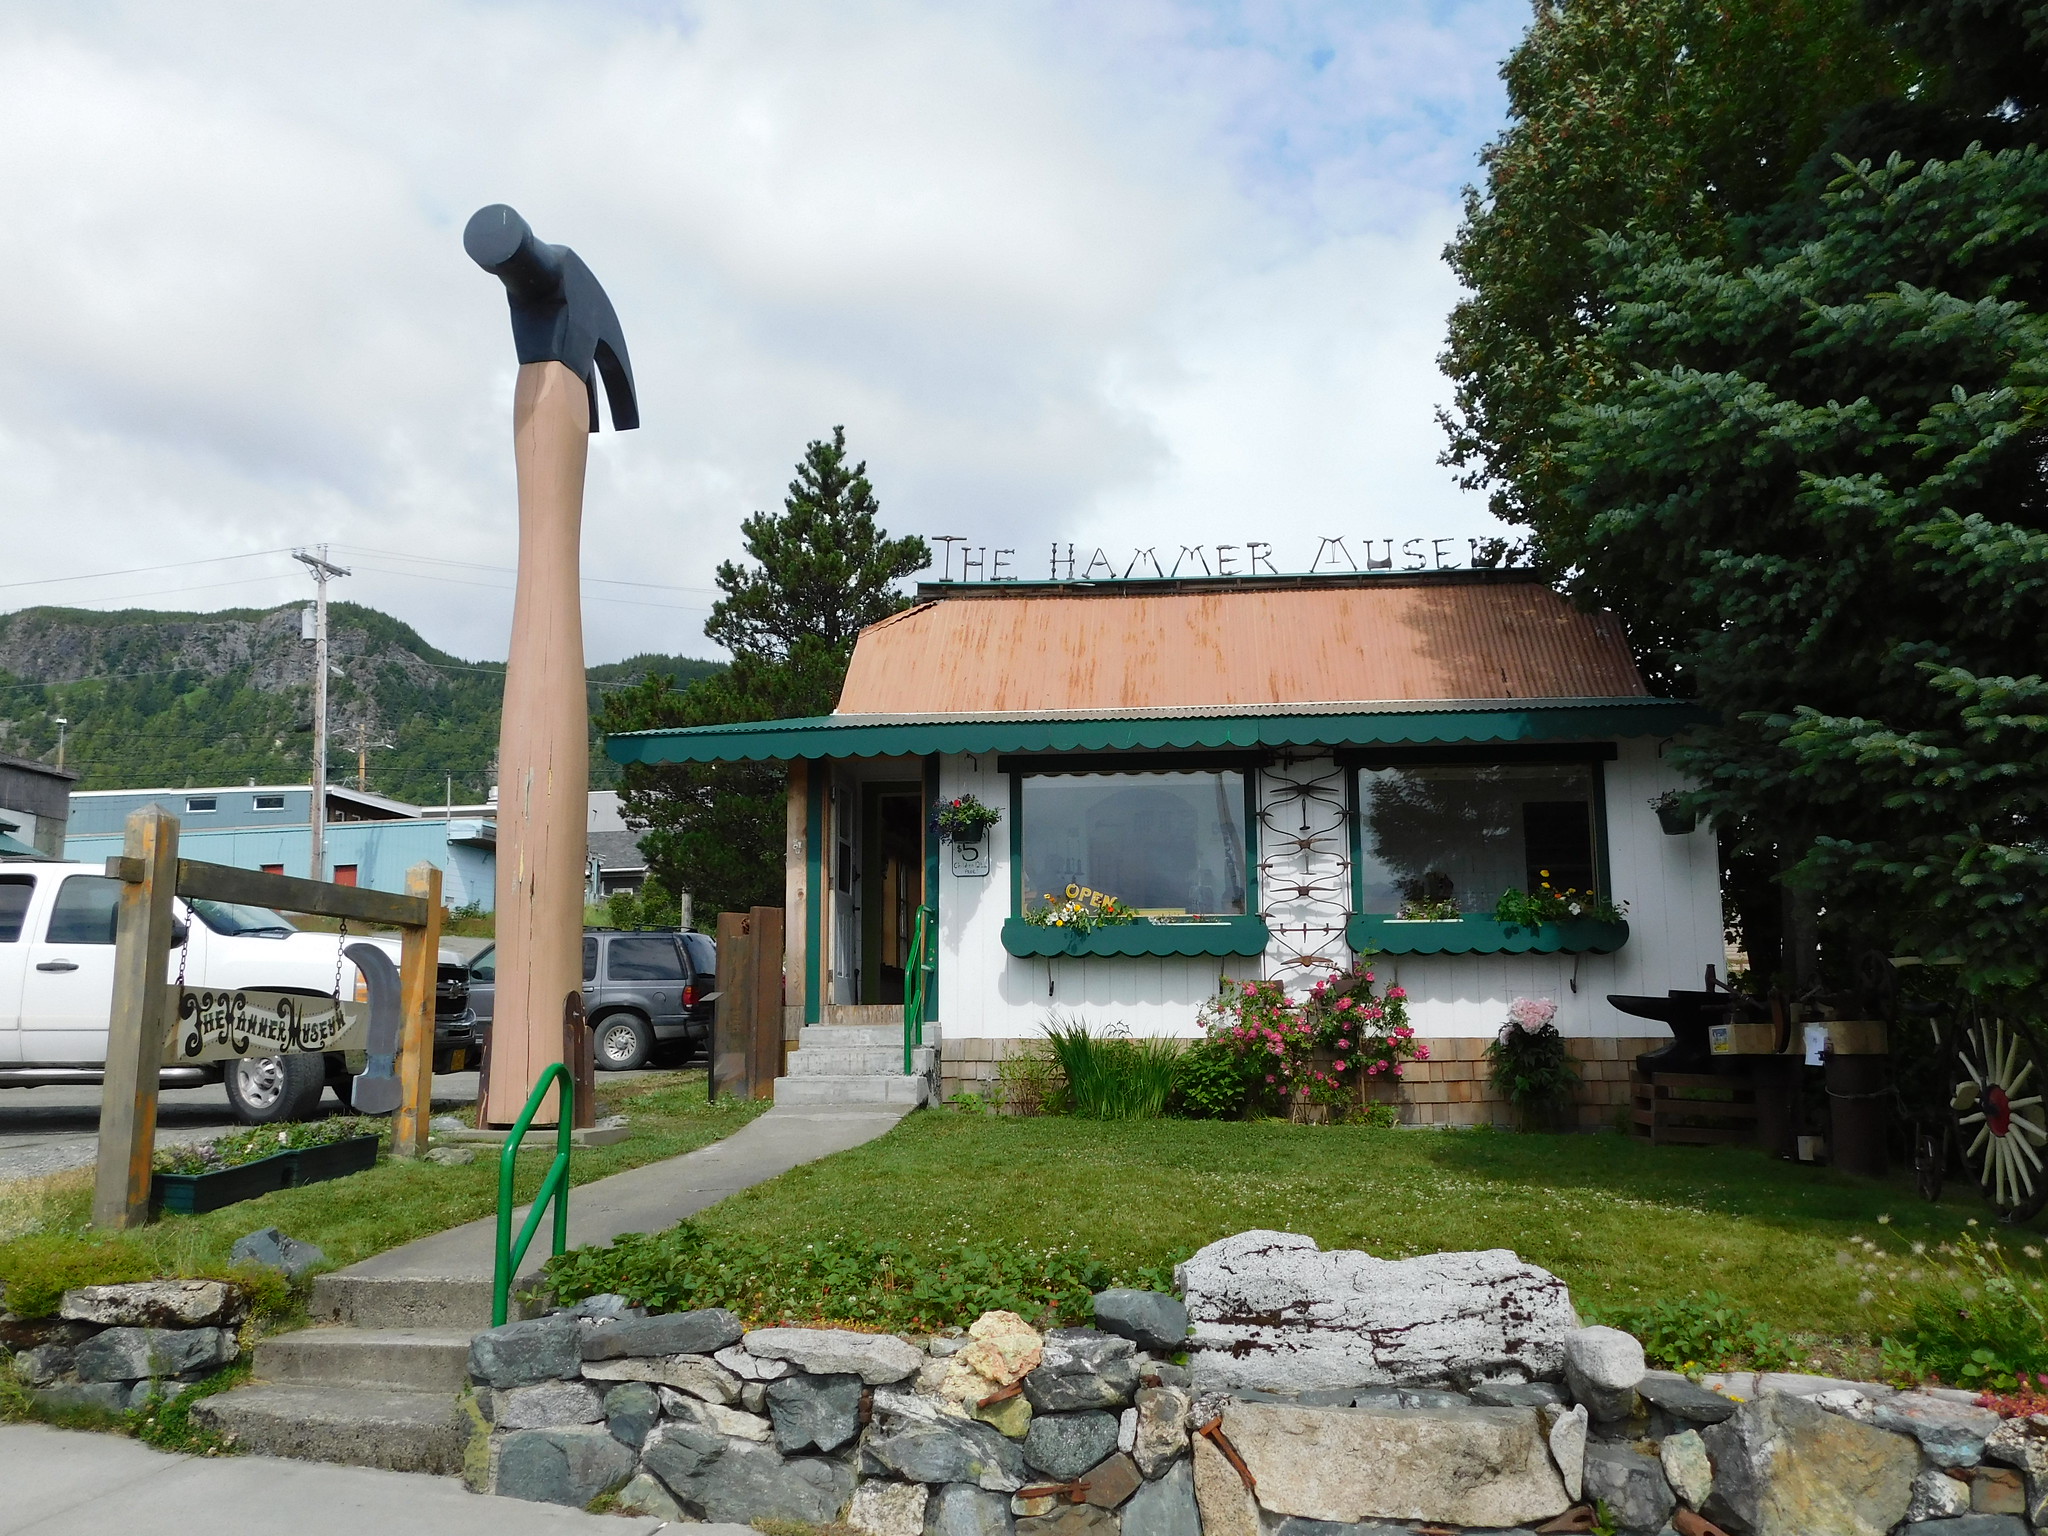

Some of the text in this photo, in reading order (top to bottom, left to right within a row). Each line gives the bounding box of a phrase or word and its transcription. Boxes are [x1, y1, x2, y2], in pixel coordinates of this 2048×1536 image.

[931, 535, 1018, 583] THE
[1050, 542, 1278, 581] HAMMER
[1065, 883, 1118, 909] OPEN
